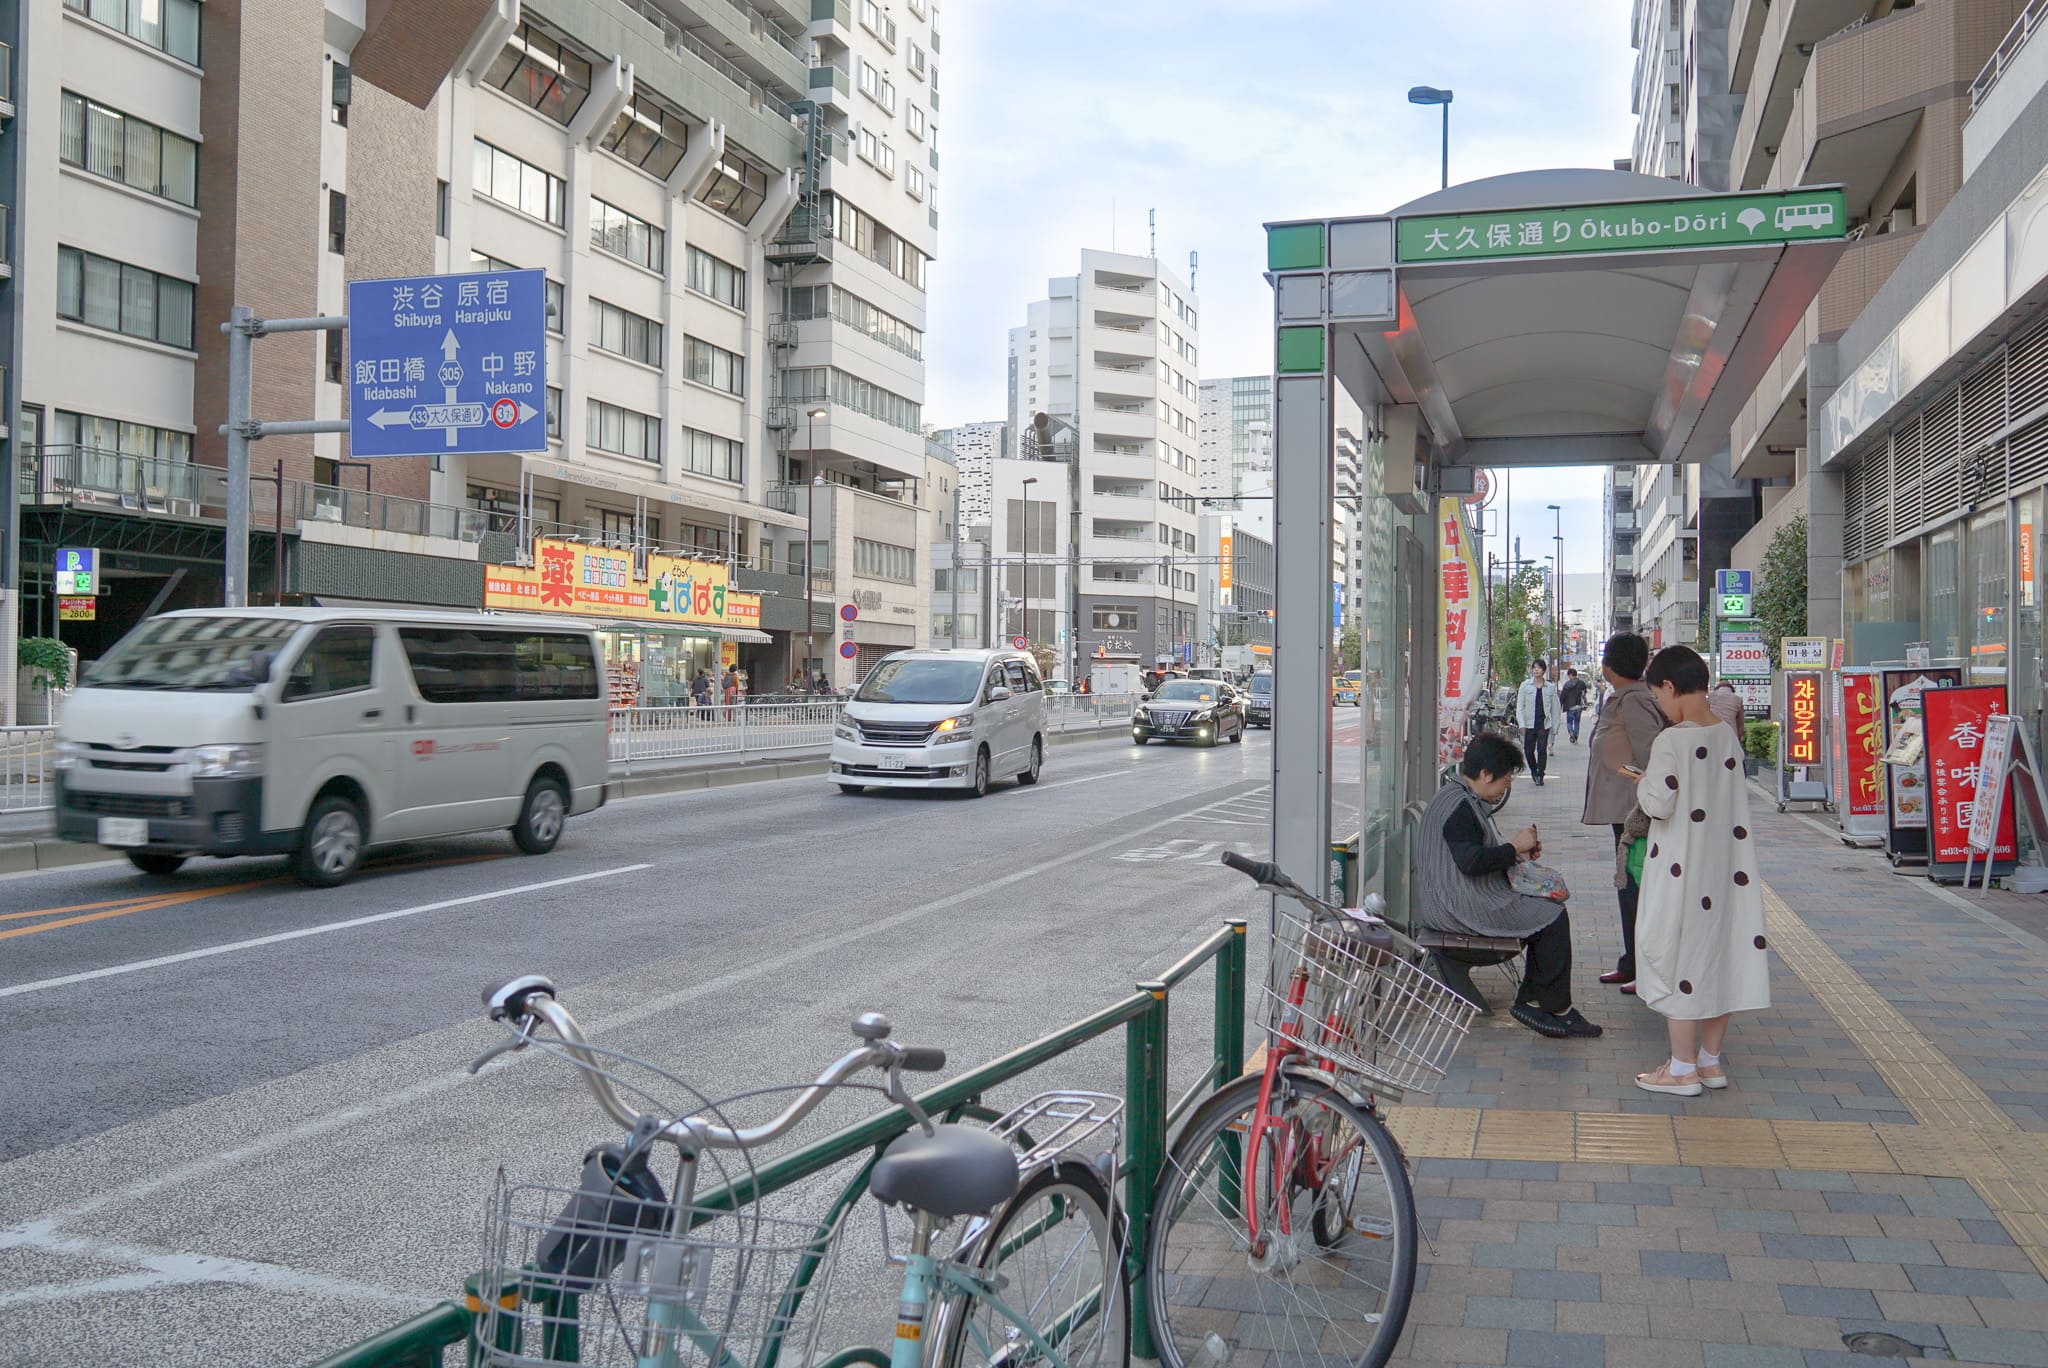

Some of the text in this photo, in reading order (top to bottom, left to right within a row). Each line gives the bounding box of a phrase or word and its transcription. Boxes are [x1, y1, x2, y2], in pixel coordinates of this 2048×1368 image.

[1580, 210, 1728, 240] Ōkubo-Dōri
[1424, 219, 1571, 253] 大久保通り
[392, 279, 509, 311] 渋谷 原宿
[394, 308, 512, 328] Shibuya Harajuku
[355, 356, 426, 385] 飯田橋
[482, 350, 536, 379] 中野
[441, 368, 460, 381] 305
[364, 385, 417, 400] Iidabashi
[485, 381, 533, 395] Nakano
[411, 411, 428, 424] 433
[430, 408, 482, 424] 大久保通り
[67, 551, 80, 571] P
[541, 545, 575, 607] 薬
[1725, 571, 1740, 588] P
[70, 610, 90, 618] 2800
[1725, 649, 1761, 660] 2800
